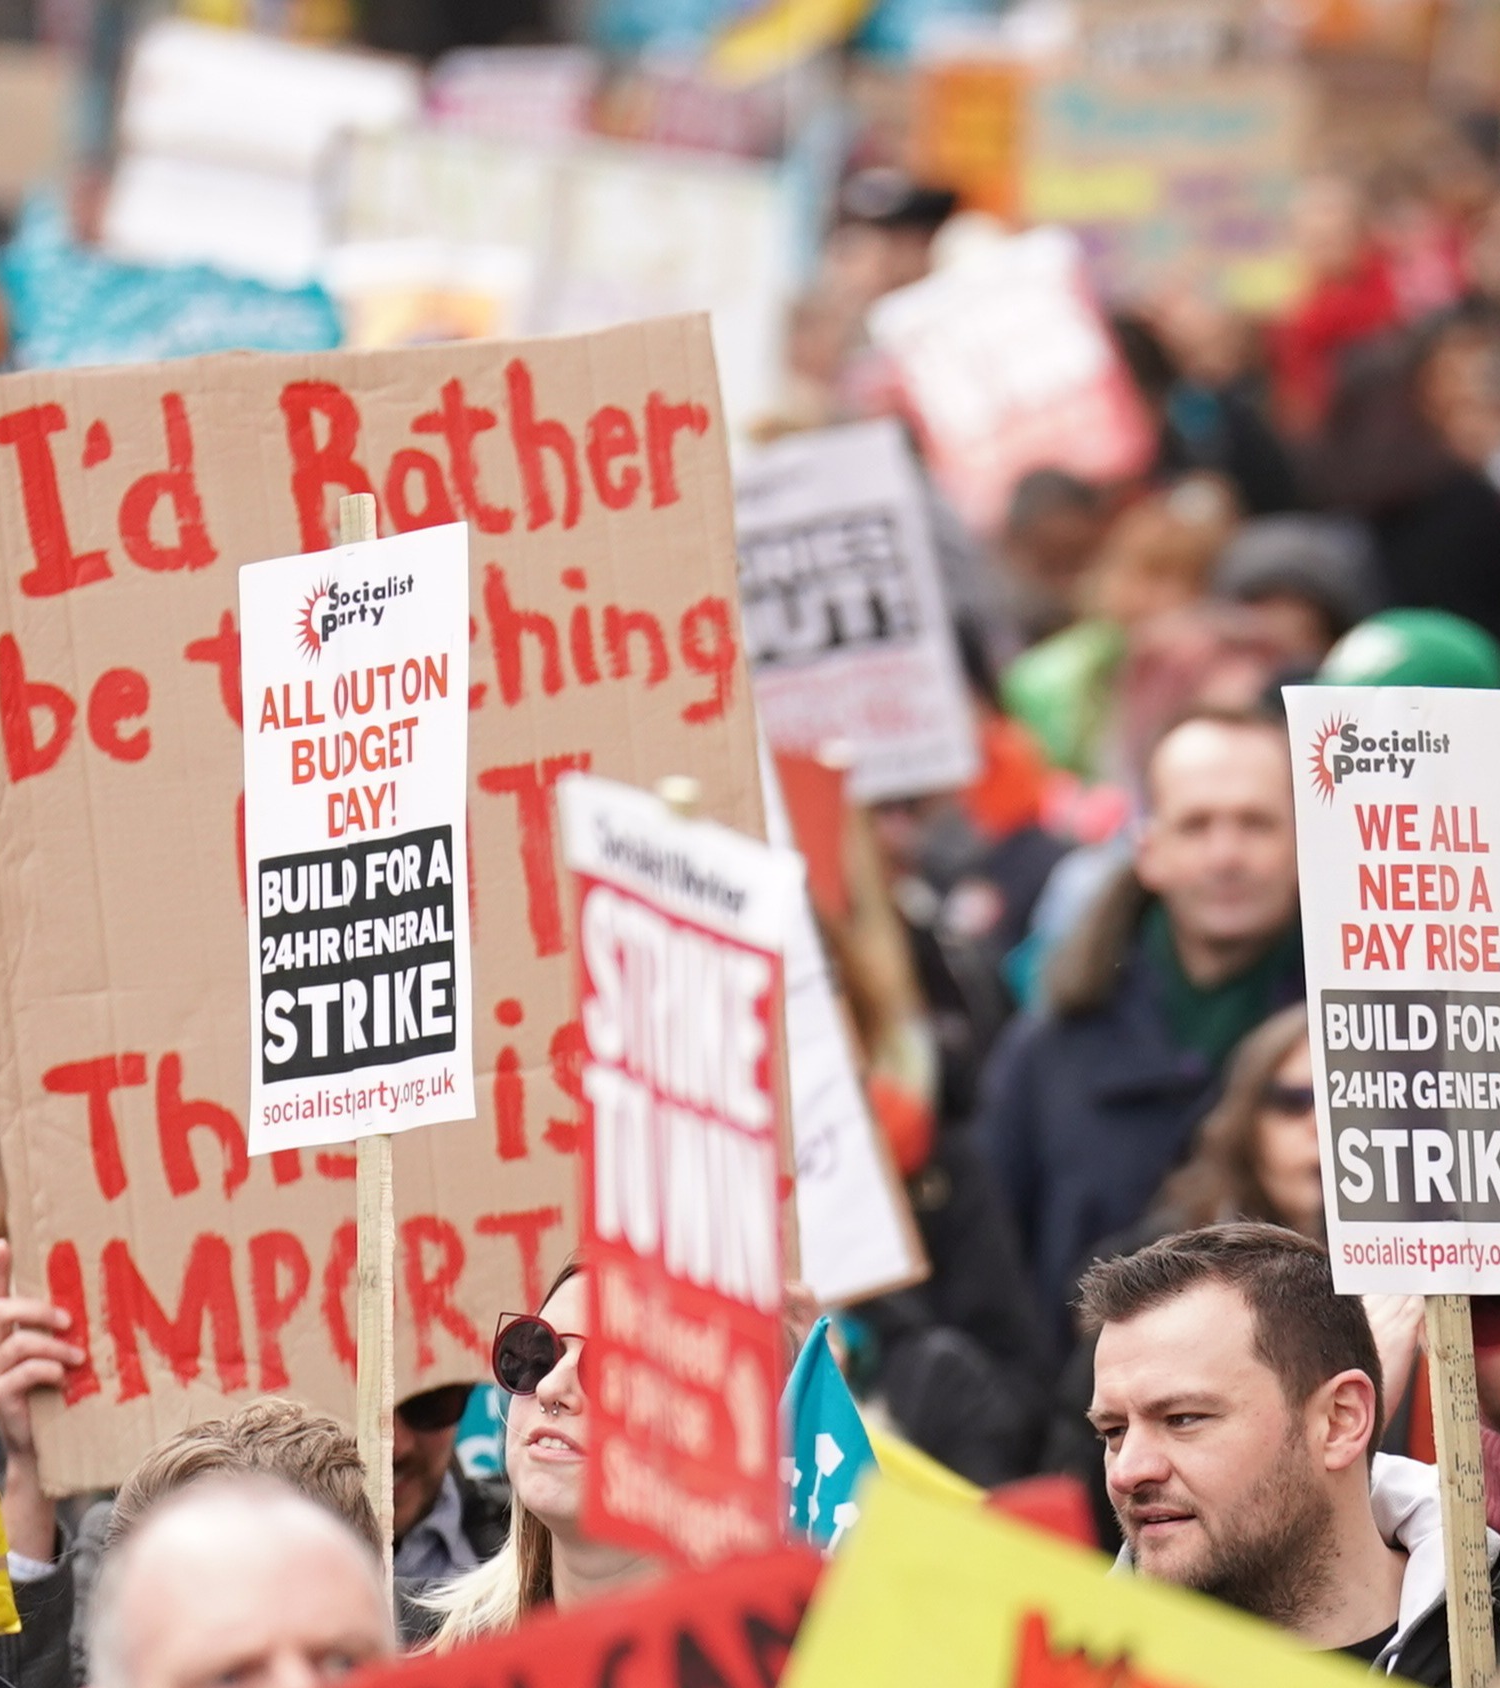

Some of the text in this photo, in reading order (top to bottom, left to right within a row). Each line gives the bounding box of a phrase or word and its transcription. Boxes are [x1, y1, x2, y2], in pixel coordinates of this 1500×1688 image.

[327, 573, 415, 612] Socialist
[184, 560, 738, 728] thing
[320, 603, 386, 643] Party
[259, 652, 449, 734] ALL OUT ON
[291, 716, 420, 786] BUDGET
[1339, 723, 1451, 754] Socialist
[1332, 753, 1416, 785] Party
[327, 780, 397, 839] DAY!
[1354, 804, 1490, 854] WE ALL
[261, 838, 452, 919] BUILD FOR A
[1358, 863, 1494, 913] NEED A
[261, 904, 454, 975] 24HR GENERAL
[1340, 923, 1415, 971] PAY
[263, 960, 453, 1065] STRIKE
[1324, 1003, 1438, 1051] BUILD
[262, 1066, 456, 1127] socialistarty.org.uk
[1329, 1070, 1408, 1110] 24HR
[42, 1048, 360, 1203] Th
[46, 1205, 564, 1408] IMPORT
